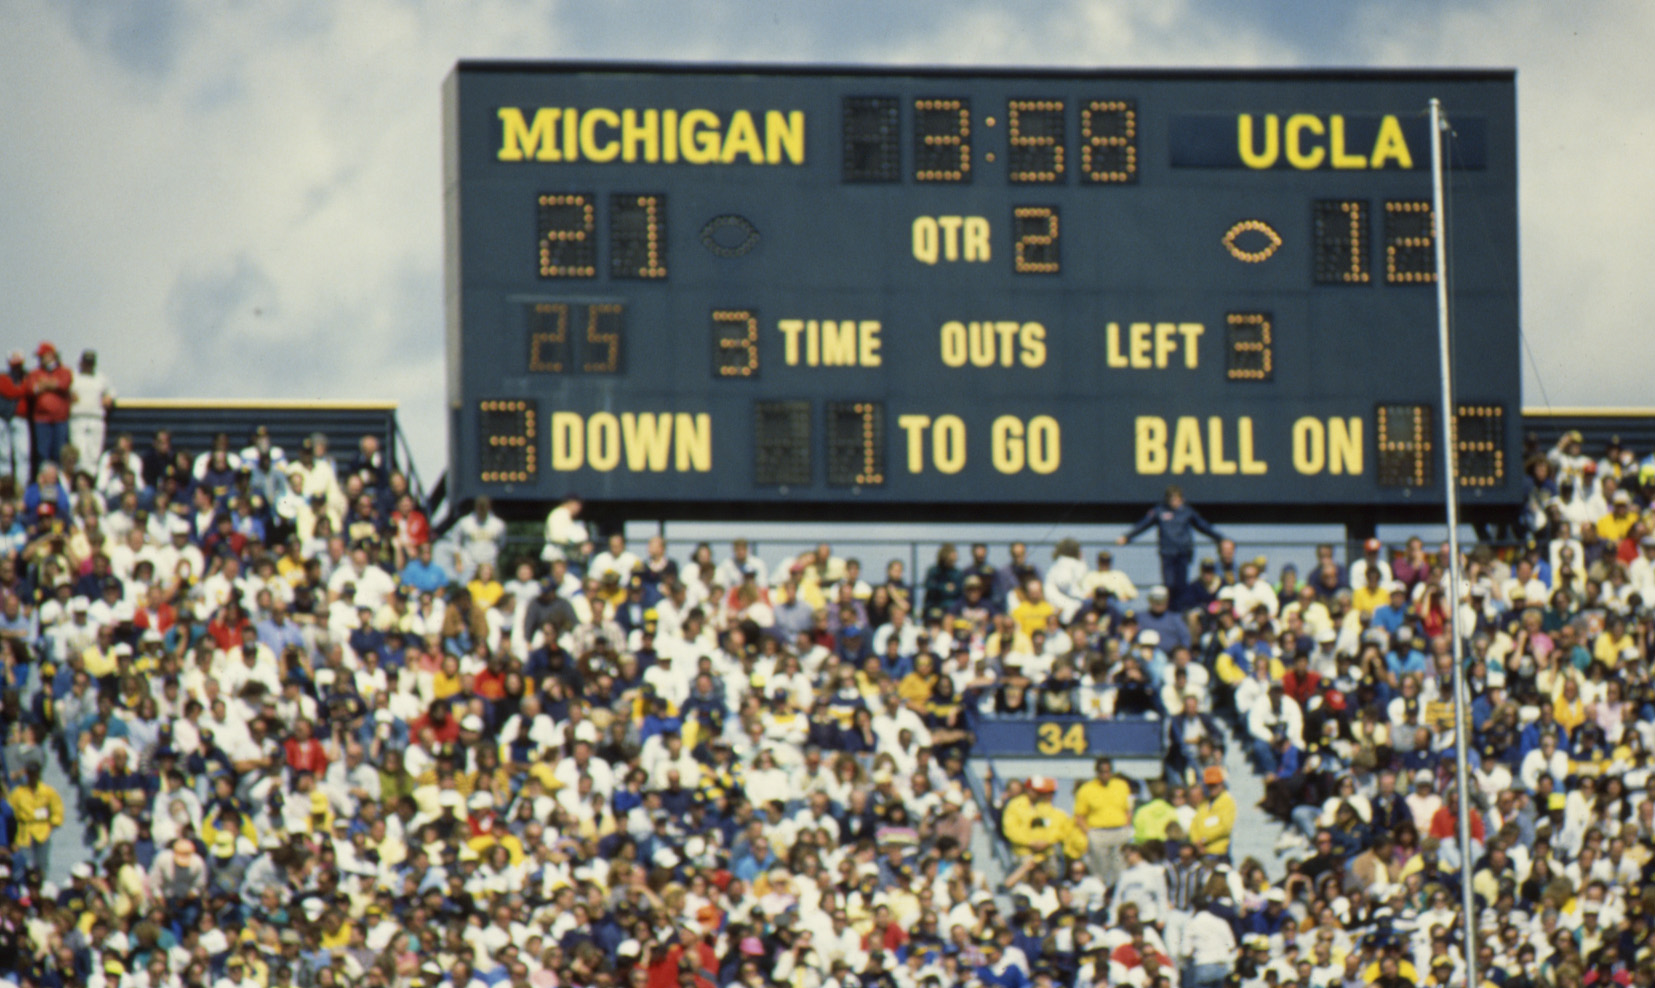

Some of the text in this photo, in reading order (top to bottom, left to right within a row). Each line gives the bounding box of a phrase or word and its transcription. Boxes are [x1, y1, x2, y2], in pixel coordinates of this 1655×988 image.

[497, 107, 804, 164] MICHIGAN
[915, 99, 1137, 182] 3:58
[1237, 113, 1412, 169] UCLA
[538, 195, 667, 278] 21
[912, 208, 1059, 273] QTR 2
[1340, 200, 1438, 283] 12
[528, 303, 623, 373] 25
[712, 311, 1272, 379] 3 TIME OUTS LEFT 3
[480, 400, 537, 483] 3
[552, 412, 712, 472] DOWN
[898, 414, 967, 474] TO
[992, 416, 1061, 474] GO
[1135, 416, 1267, 475] BALL
[1292, 417, 1363, 475] ON
[1037, 722, 1088, 756] 34
